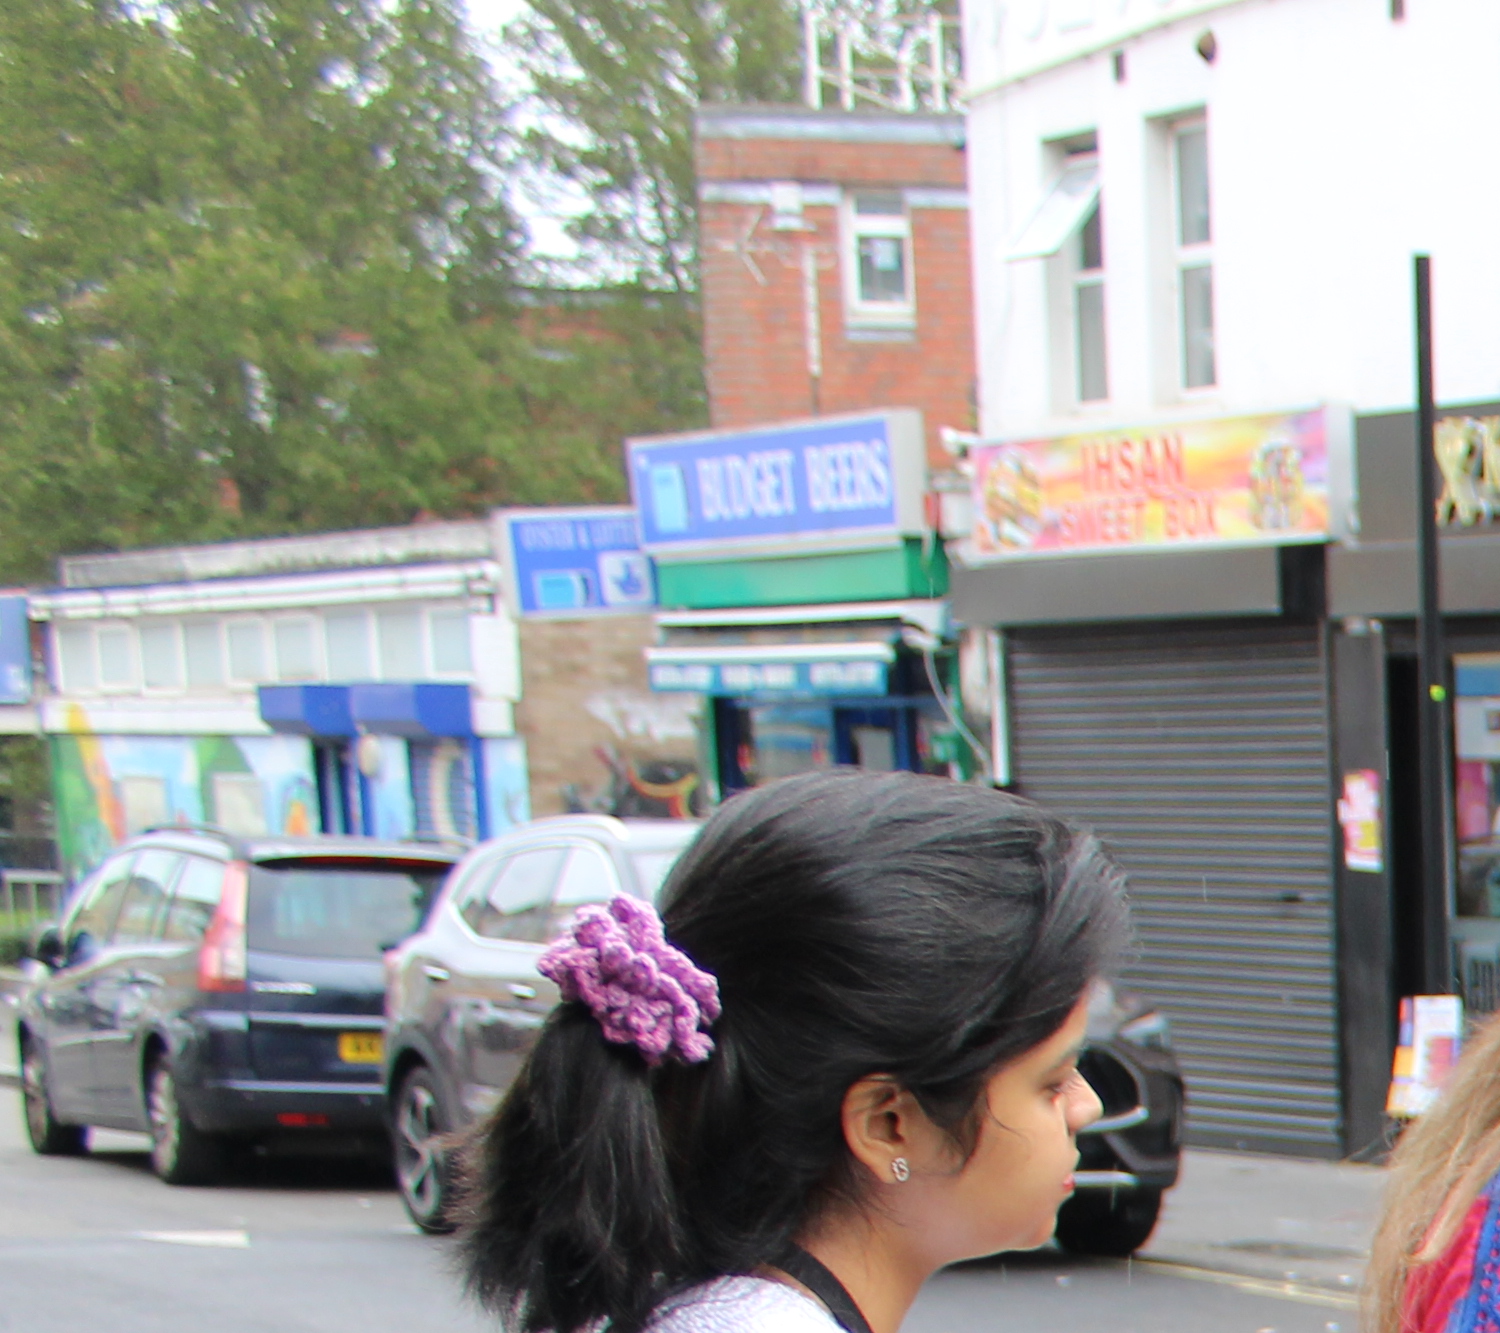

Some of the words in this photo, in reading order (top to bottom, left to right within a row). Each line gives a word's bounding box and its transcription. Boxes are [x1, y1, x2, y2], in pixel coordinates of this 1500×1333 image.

[695, 448, 797, 521] BUDGET
[804, 437, 893, 513] BEERS
[1080, 431, 1186, 494] IHSAN
[1060, 497, 1146, 547] SWEET
[1165, 493, 1219, 541] BOX
